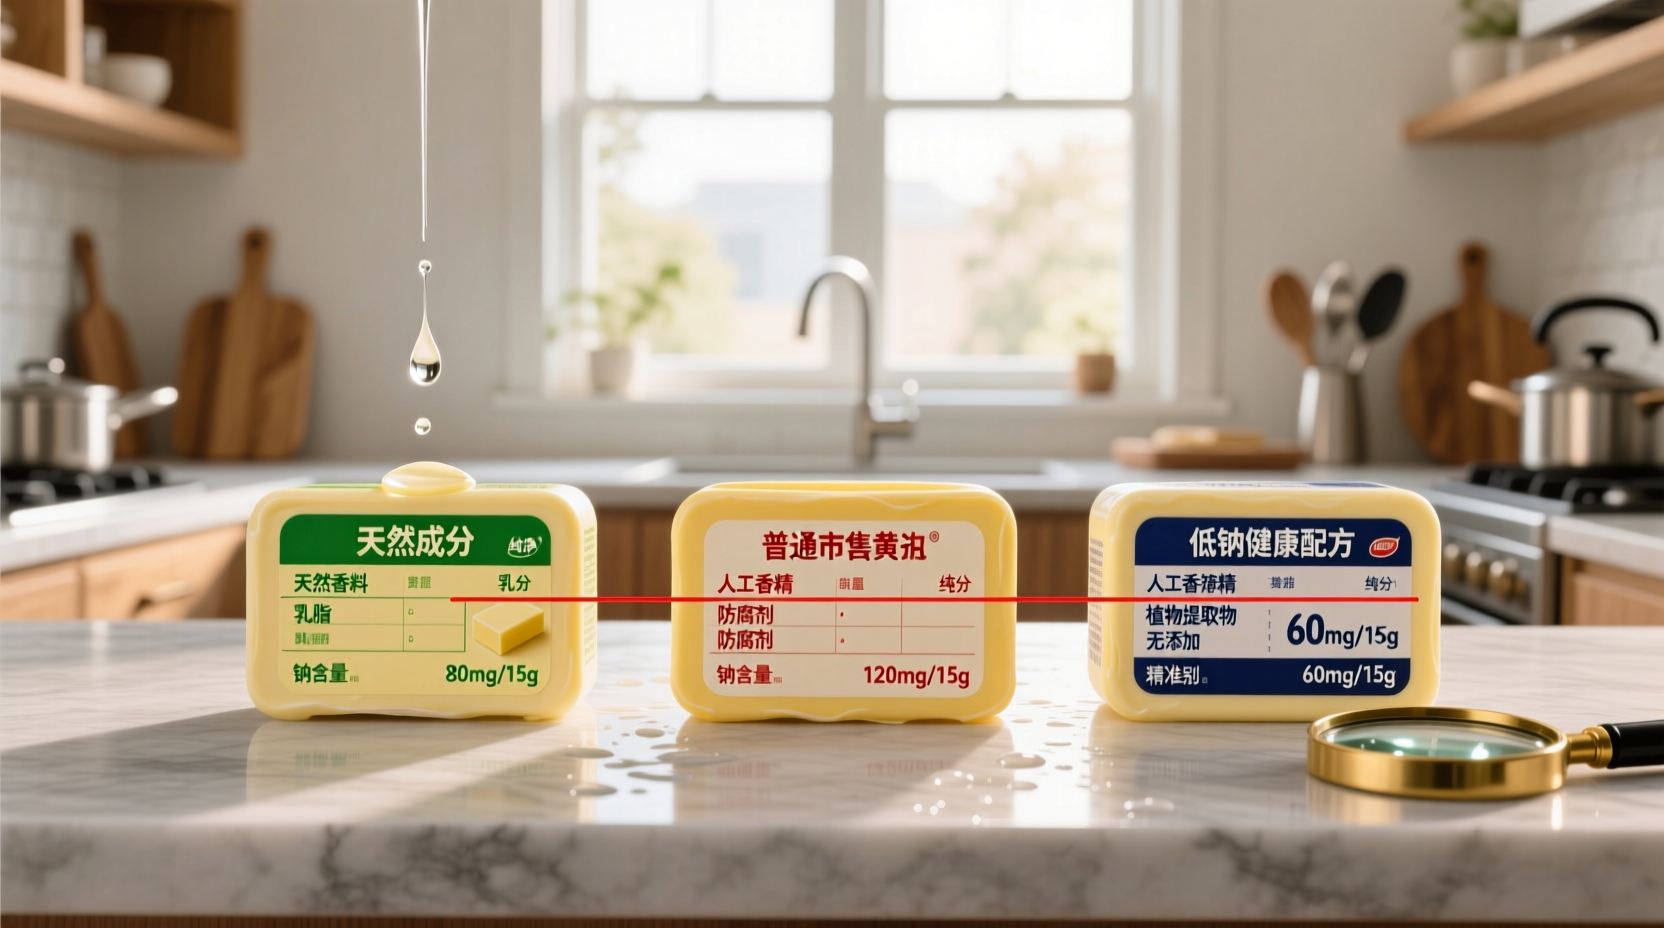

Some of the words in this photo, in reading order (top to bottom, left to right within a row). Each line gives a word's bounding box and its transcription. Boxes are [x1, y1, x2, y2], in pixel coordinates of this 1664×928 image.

[357, 525, 474, 557] 天然成分
[1189, 527, 1355, 558] 低钠健康配方
[294, 573, 368, 593] 天然香料
[717, 573, 793, 594] 人工香精
[294, 603, 332, 624] 乳脂
[718, 603, 774, 625] 防腐剂
[1146, 604, 1237, 626] 植物提取物
[1147, 630, 1200, 650] 无添加
[1287, 613, 1399, 649] 60mg/15g
[293, 663, 348, 684] 钠含量
[445, 664, 539, 687] 80mg/15g
[717, 664, 773, 685] 钠含量
[864, 665, 970, 689] 120mg/15g
[1303, 665, 1396, 688] 60mg/15g
